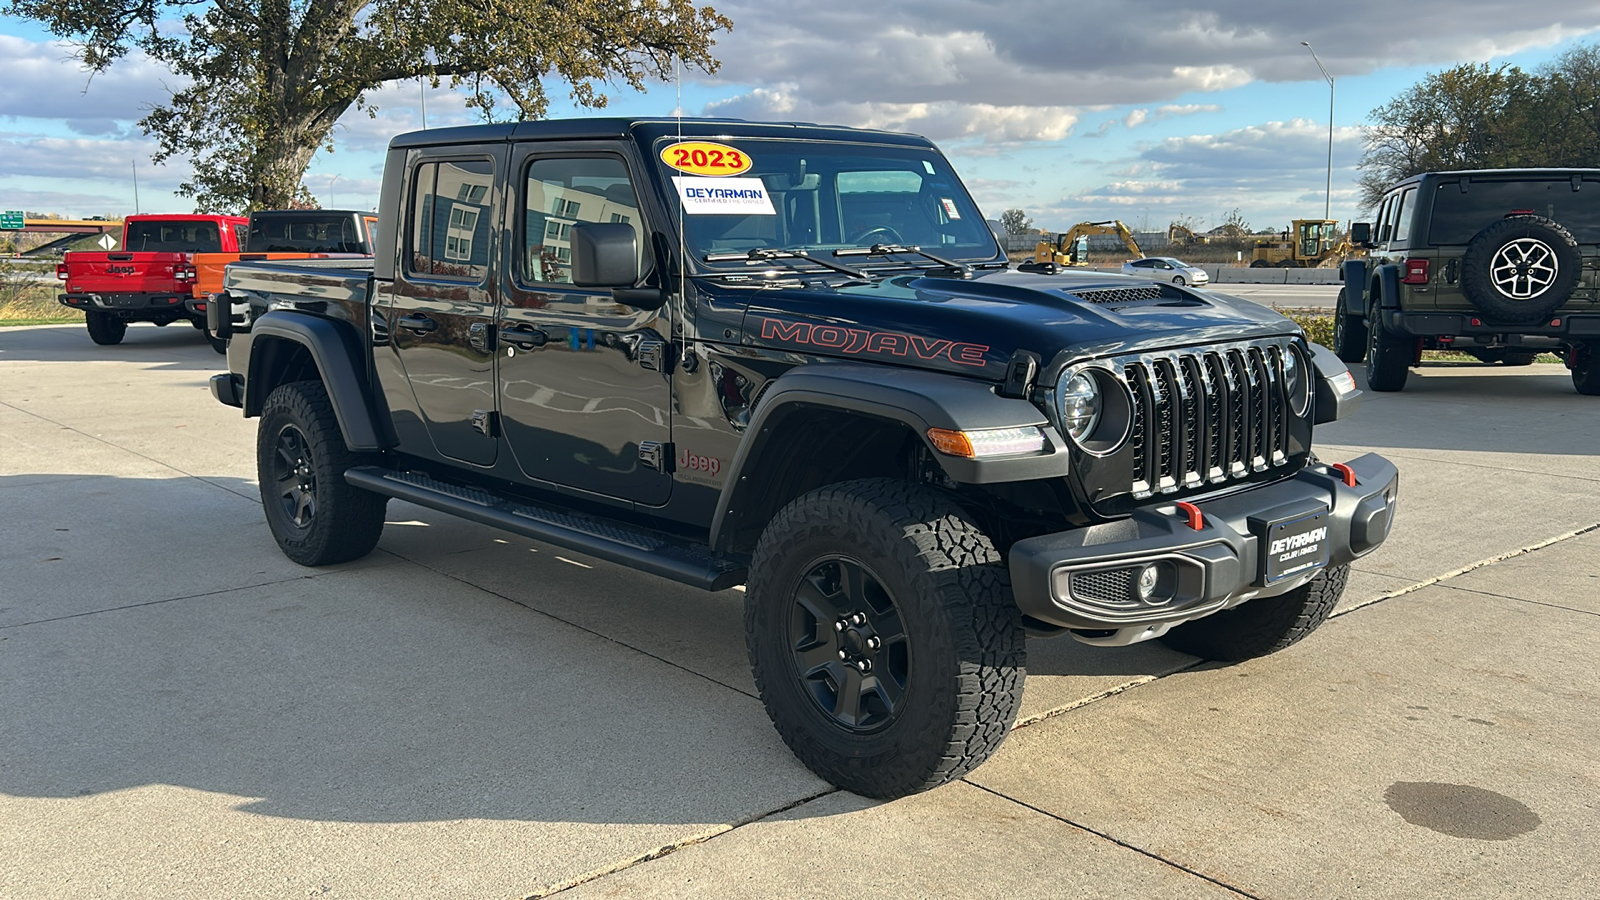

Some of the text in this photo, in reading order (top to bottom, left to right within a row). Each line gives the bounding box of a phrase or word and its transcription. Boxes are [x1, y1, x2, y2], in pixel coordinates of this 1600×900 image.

[673, 149, 743, 169] 2023
[686, 187, 763, 199] DEYARMAN
[106, 264, 136, 275] Jeep
[761, 318, 990, 367] MOJAVE
[679, 448, 720, 477] Jeep
[1269, 526, 1327, 556] DEYARMAN
